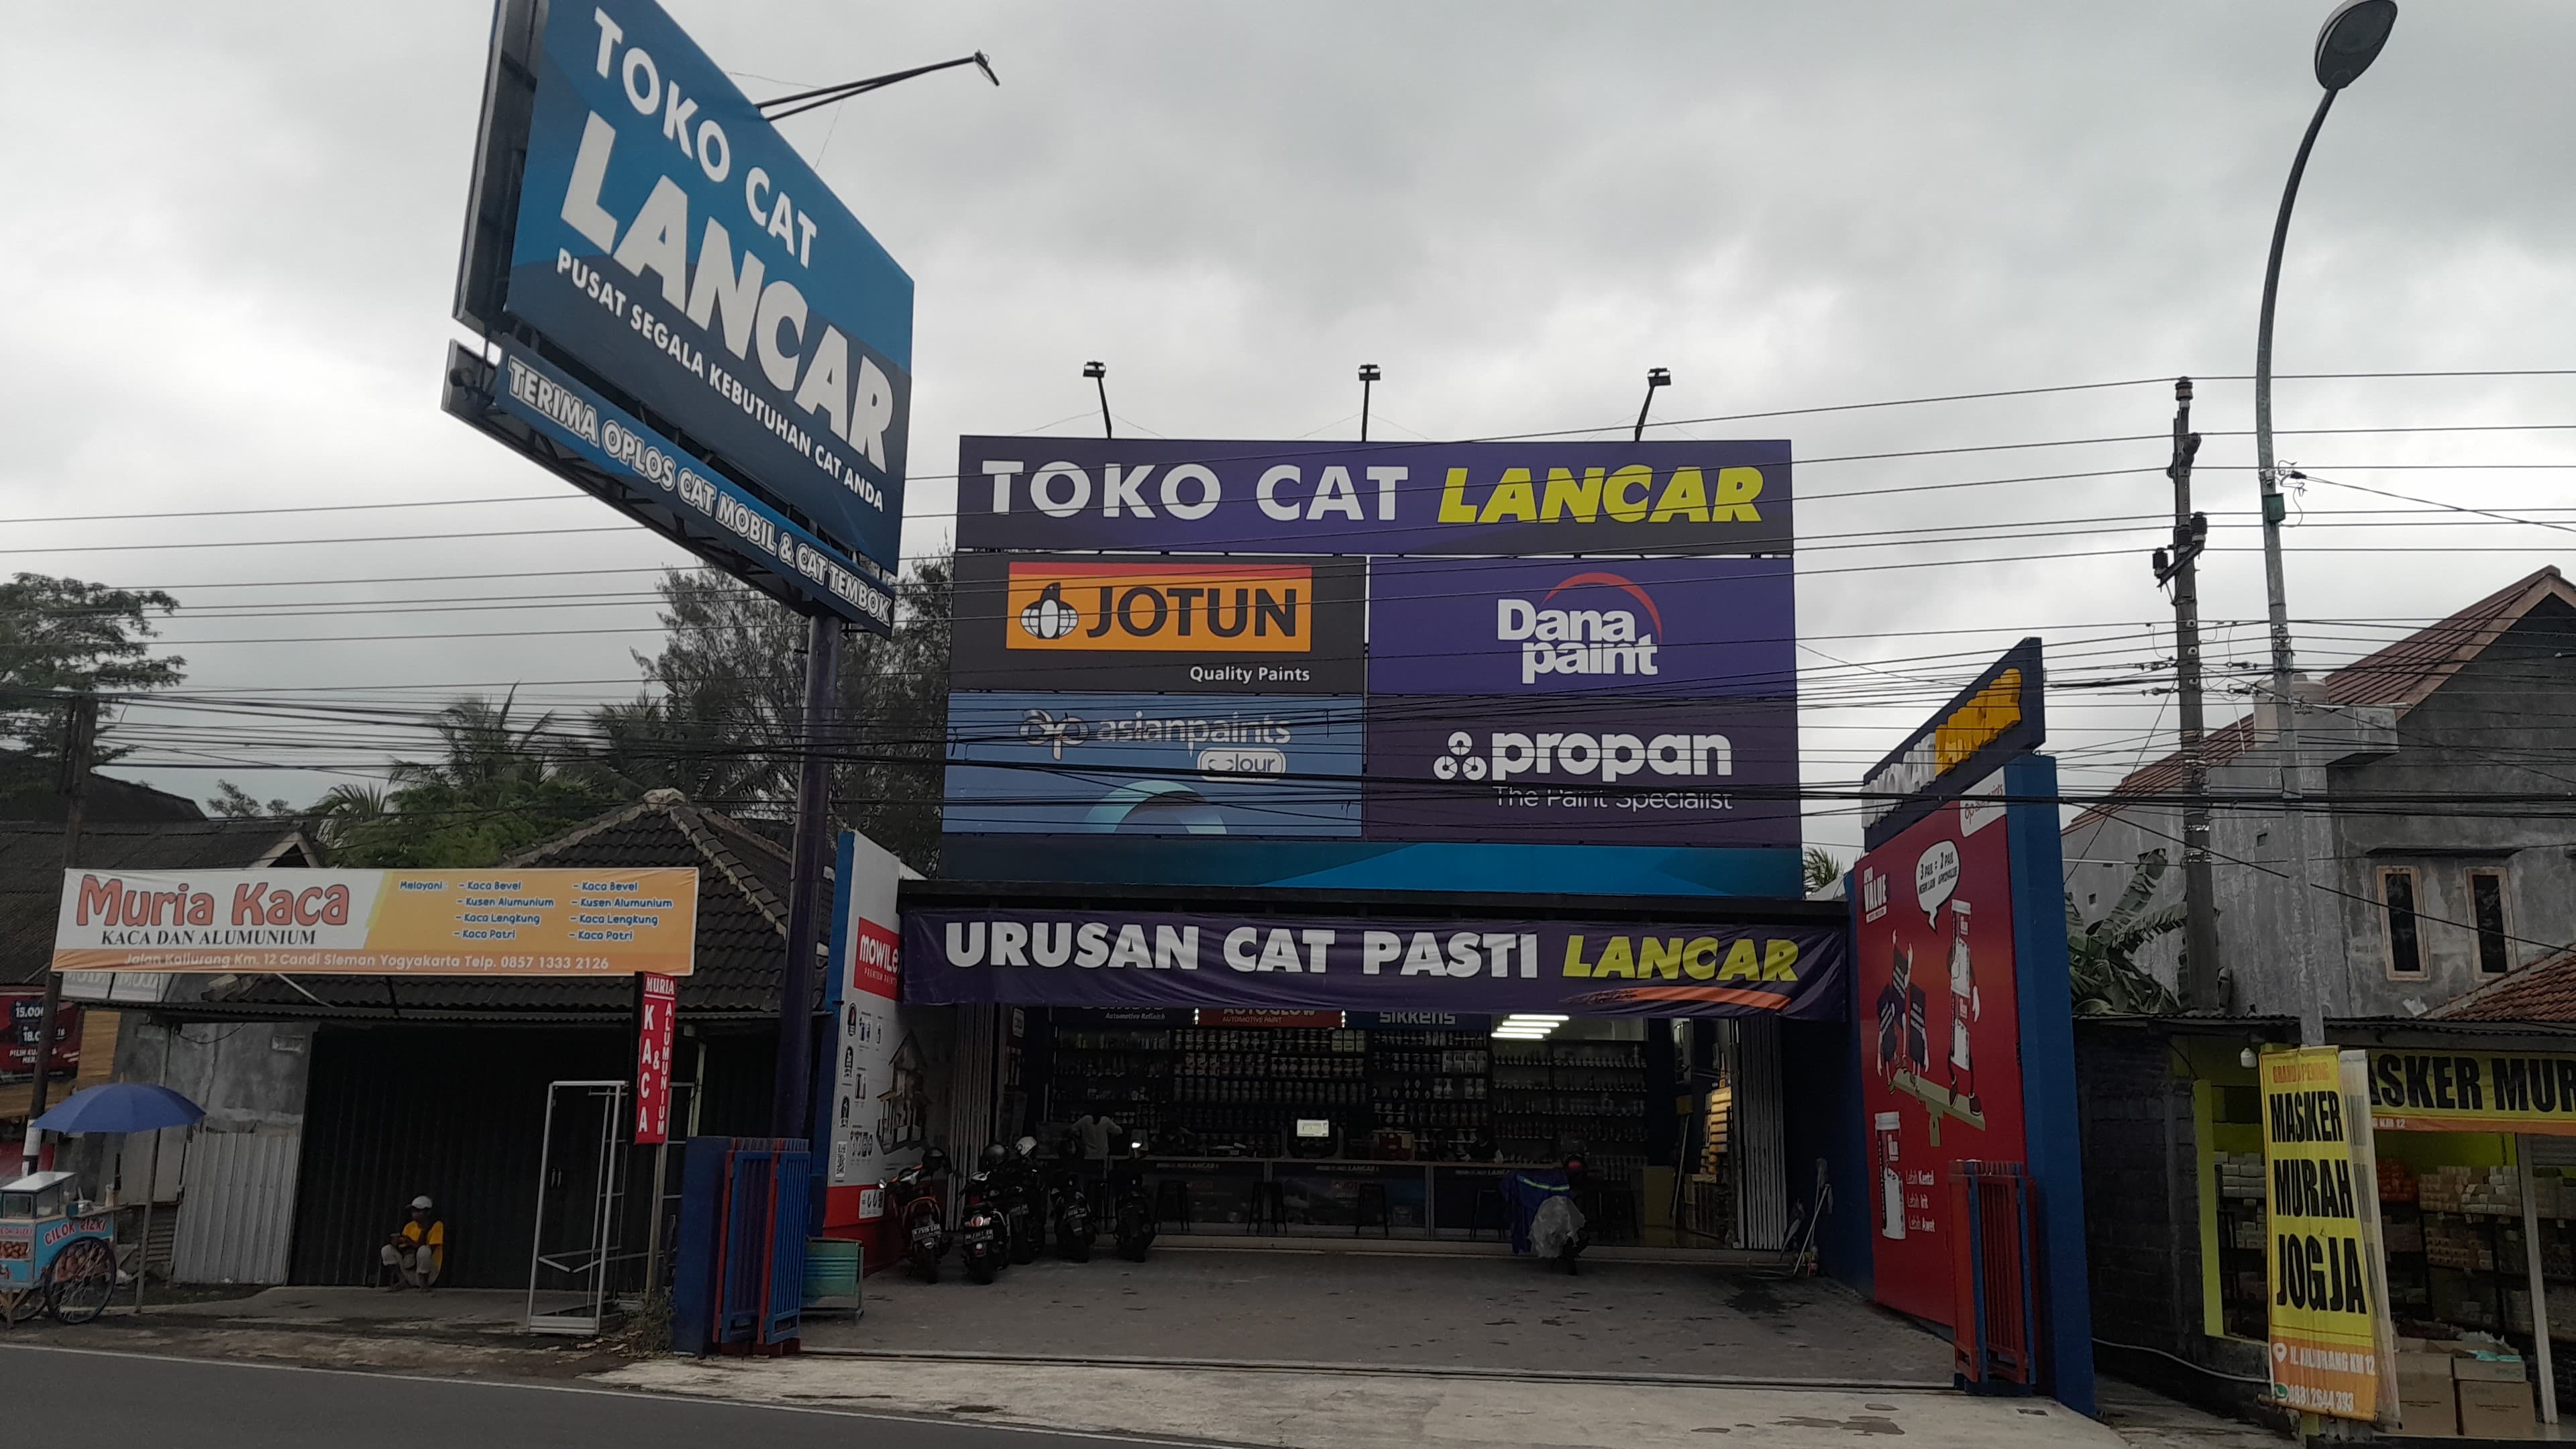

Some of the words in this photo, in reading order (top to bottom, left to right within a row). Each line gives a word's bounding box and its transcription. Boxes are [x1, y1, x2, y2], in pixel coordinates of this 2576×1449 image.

[594, 6, 731, 182] TOKO
[745, 167, 816, 268] CAT
[561, 110, 894, 474] LANCAR
[557, 248, 627, 319] PUSAT
[631, 303, 704, 379] SEGALA
[709, 362, 810, 458] KEBUTUHAN
[815, 448, 843, 480] CAT
[845, 468, 883, 513] ANDA
[507, 356, 600, 448] TERIMA
[602, 419, 676, 492] OPLOS
[678, 469, 716, 515] CAT
[717, 498, 777, 555] MOBIL
[779, 533, 795, 566] &
[796, 543, 828, 586] CAT
[828, 566, 892, 627] TEMBOK
[982, 460, 1221, 520] TOKO
[1256, 464, 1409, 521] CAT
[1438, 464, 1764, 523] LANCAR
[1086, 586, 1296, 637] JOTUN
[1497, 599, 1635, 641] Dana
[1189, 666, 1252, 683] Quality
[1258, 667, 1309, 681] Paints
[1521, 633, 1658, 684] paint
[1097, 712, 1291, 757] asianpaints
[1492, 732, 1732, 782] propan
[1492, 786, 1538, 807] The
[1547, 789, 1608, 808] Paint
[76, 874, 214, 927] Muria
[231, 881, 350, 927] Kaca
[466, 897, 495, 906] Kusen
[498, 897, 554, 907] Alumunium
[468, 881, 492, 891] Kaca
[494, 881, 521, 891] Bevel
[581, 898, 611, 908] Kusen
[614, 898, 673, 908] Alumunium
[582, 881, 607, 891] Kaca
[610, 881, 637, 892] Bevel
[1864, 873, 1887, 913] VALUE
[101, 930, 151, 946] KACA
[157, 930, 195, 946] DAN
[199, 930, 317, 946] ALUMUNIUM
[463, 929, 487, 939] Kaca
[490, 929, 515, 939] Patri
[464, 913, 488, 923] Kaca
[491, 913, 540, 925] Lengkung
[578, 930, 603, 940] Kaca
[606, 930, 633, 940] Patri
[579, 914, 604, 924] Kaca
[608, 914, 658, 926] Lengkung
[123, 953, 160, 965] Jalan
[165, 953, 230, 967] Kaliurang
[235, 953, 260, 965] Km.
[264, 953, 276, 965] 12
[280, 954, 319, 966] Candi
[323, 954, 374, 967] Sleman
[380, 954, 460, 971] Yogyakarta
[464, 955, 496, 970] Telp.
[501, 957, 534, 969] 0857
[539, 957, 572, 969] 1333
[576, 957, 609, 970] 2126
[945, 922, 1199, 969] URUSAN
[1223, 927, 1335, 973] CAT
[1362, 930, 1538, 979] PASTI
[1562, 935, 1799, 981] LANCAR
[646, 977, 675, 996] MURIA
[637, 1004, 655, 1134] KACA
[653, 1050, 660, 1070] &
[657, 1002, 673, 1136] ALUMUNIUM
[2269, 1091, 2344, 1143] MASKER
[2396, 1118, 2406, 1128] 12
[2273, 1159, 2355, 1219] MURAH
[44, 1220, 76, 1246] CILOK
[2276, 1233, 2367, 1314] JOGJA
